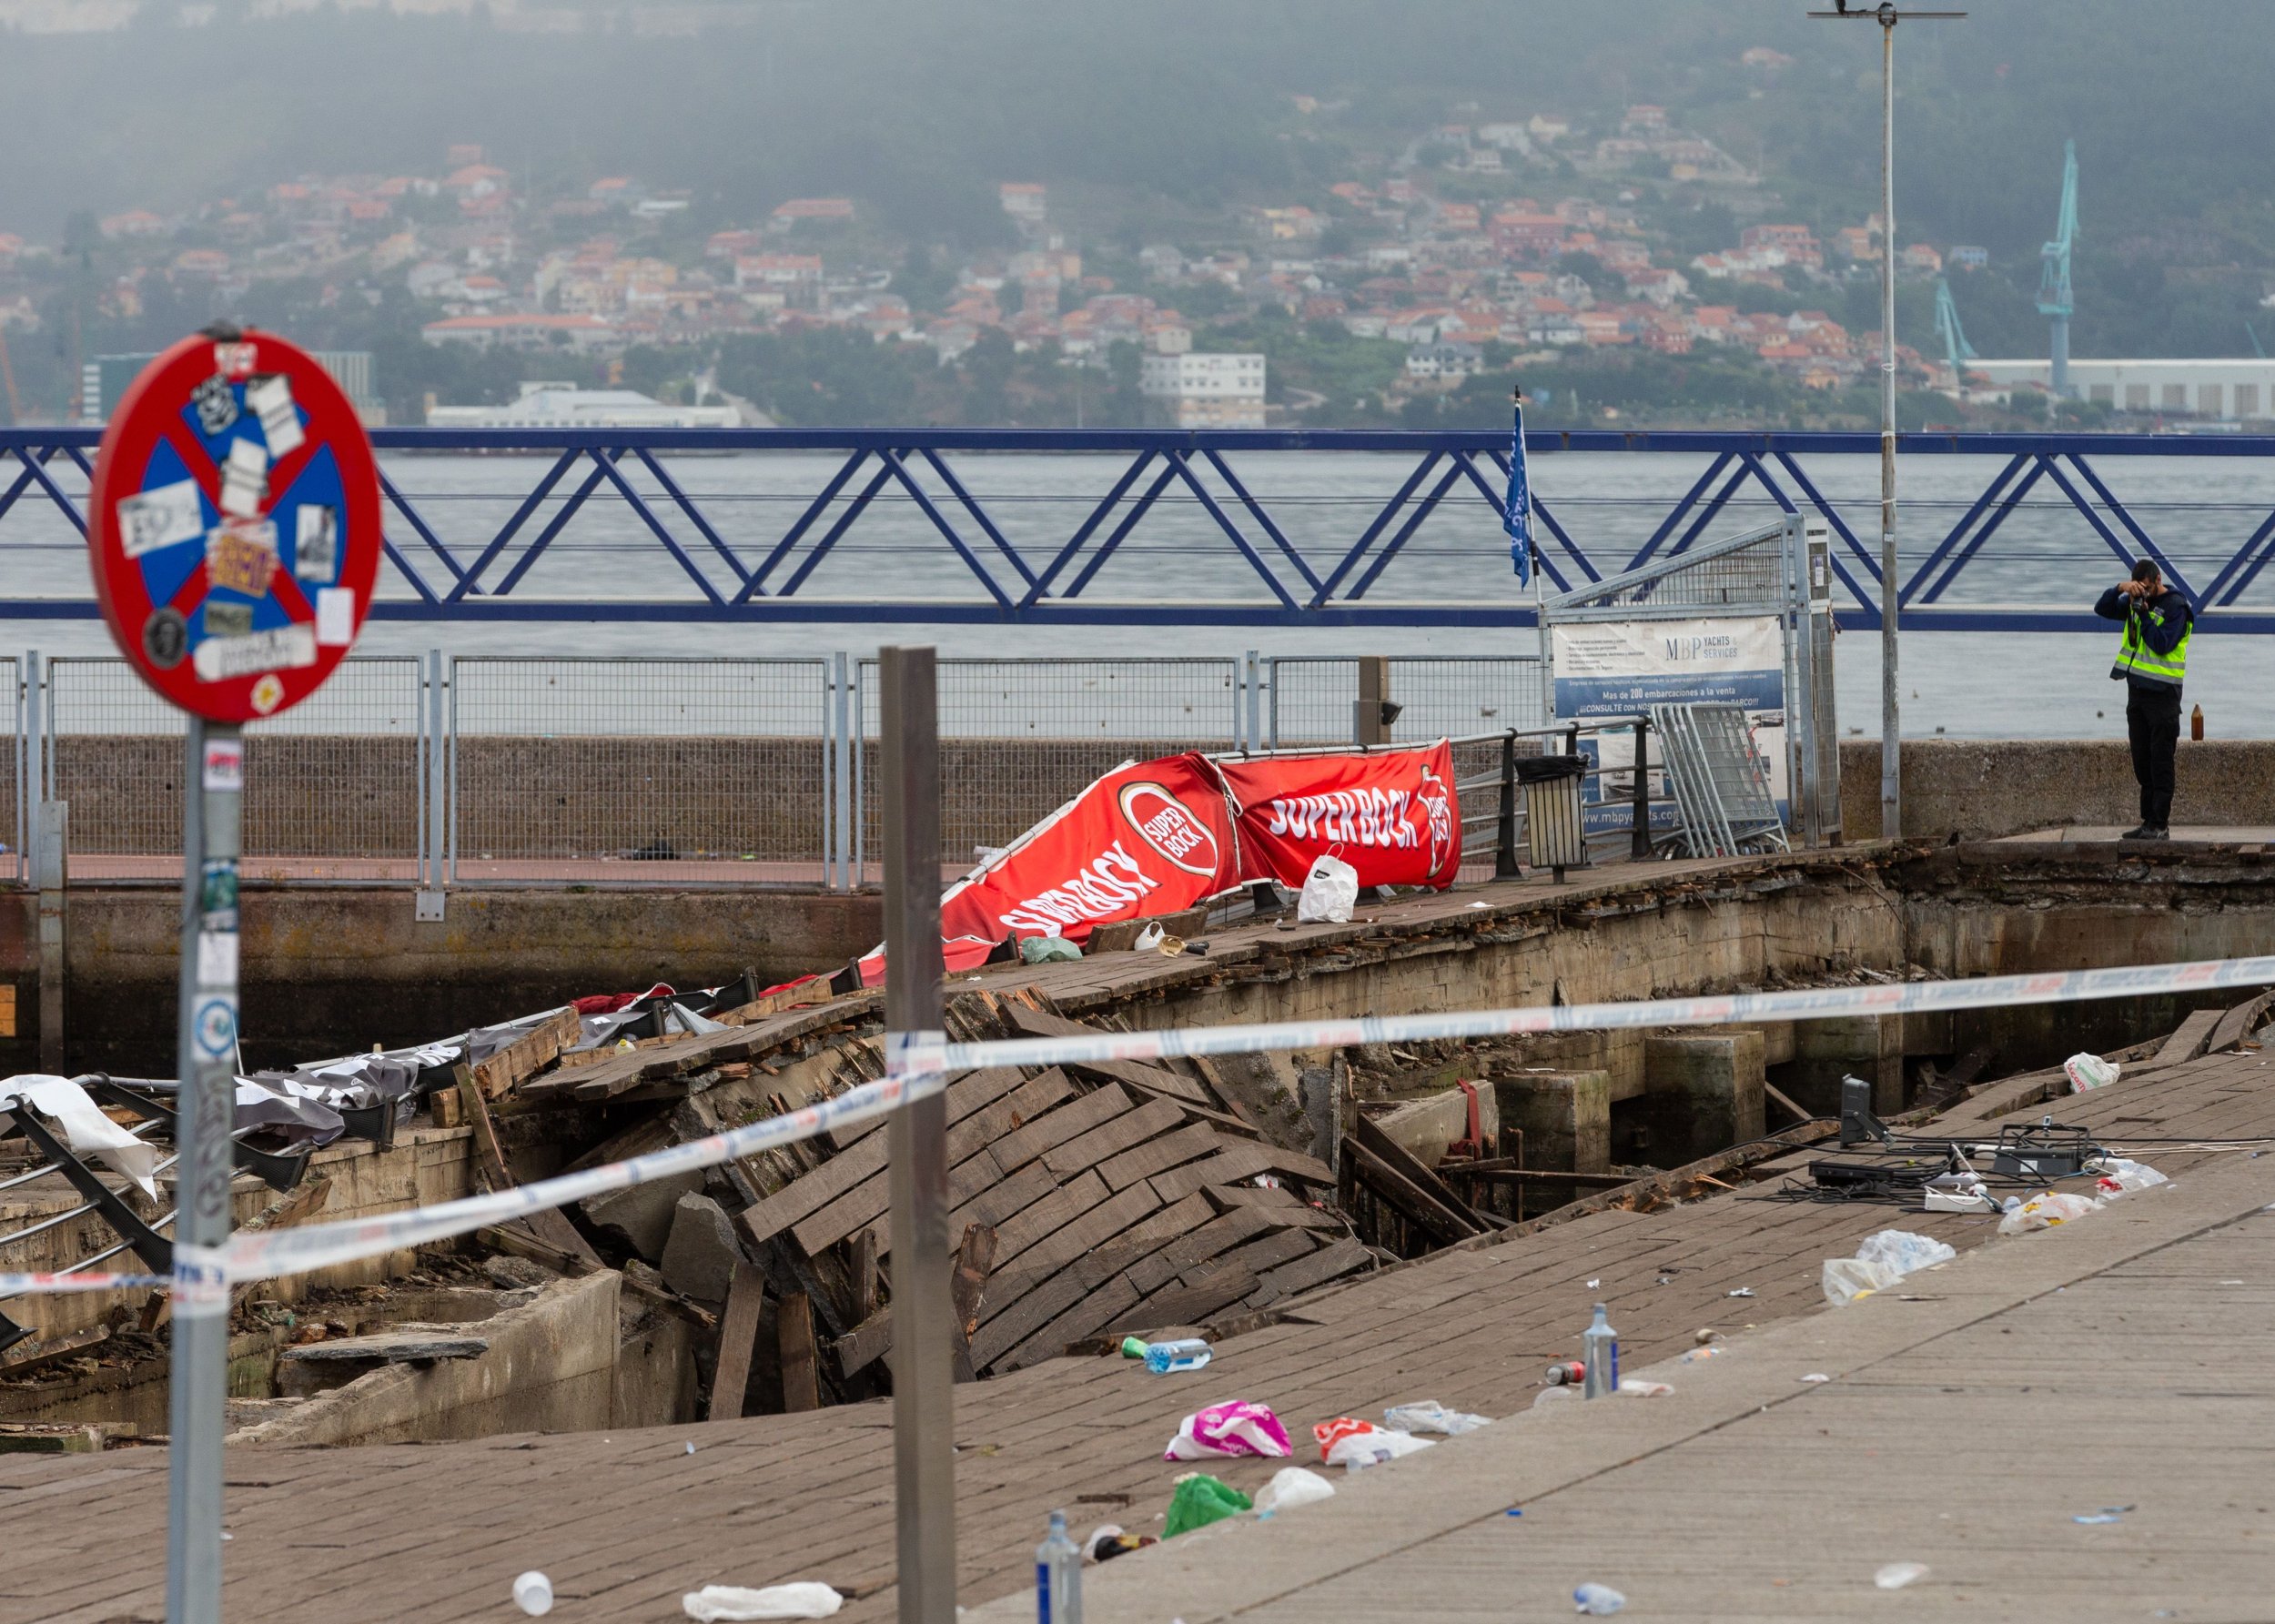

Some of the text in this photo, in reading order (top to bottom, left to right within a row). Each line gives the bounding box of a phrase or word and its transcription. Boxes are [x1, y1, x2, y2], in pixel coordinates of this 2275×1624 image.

[1666, 638, 1701, 661] MBP
[1704, 636, 1730, 646] YACHTS
[1704, 648, 1738, 659] SERVICES
[1603, 691, 1618, 700] Mas
[1630, 688, 1643, 699] 200
[1644, 690, 1698, 698] embarcaciones
[1144, 807, 1187, 842] SUPER
[1269, 787, 1419, 848] SUPER BOCK
[1163, 824, 1204, 858] BOCK
[1062, 840, 1159, 910] BOCK
